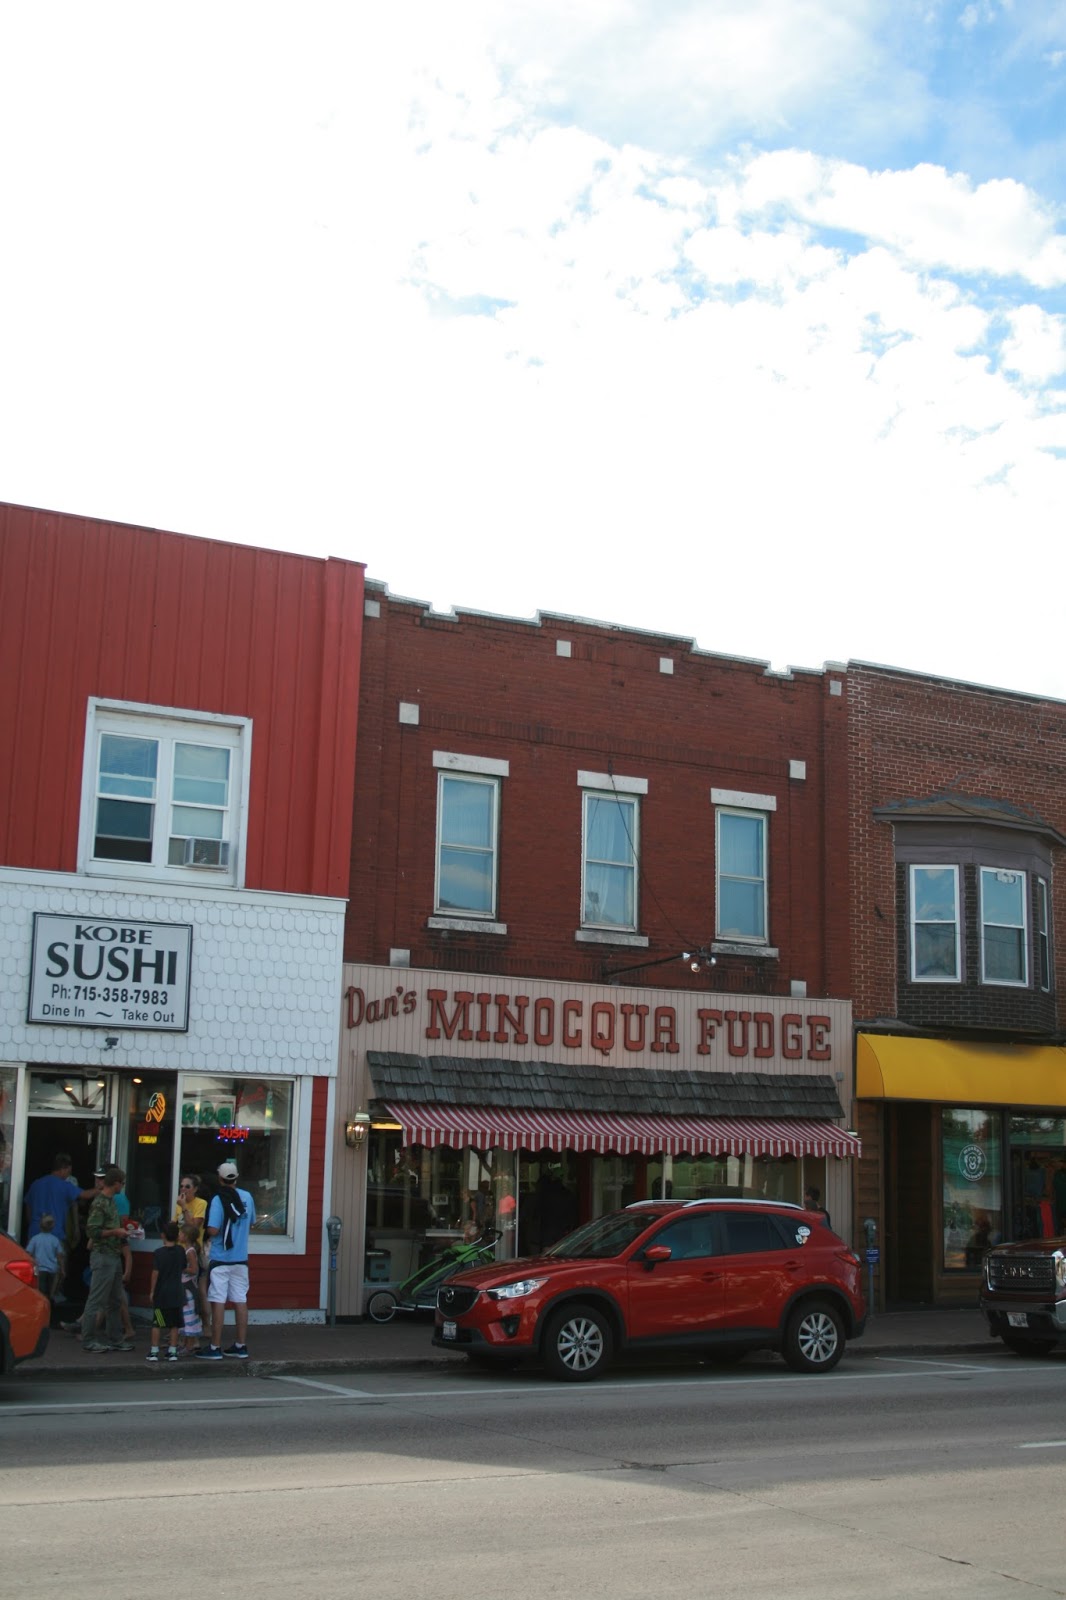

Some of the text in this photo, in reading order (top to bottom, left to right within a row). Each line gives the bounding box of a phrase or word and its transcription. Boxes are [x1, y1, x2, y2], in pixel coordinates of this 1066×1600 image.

[75, 925, 152, 945] KOBE
[46, 942, 178, 985] SUSHI
[42, 1004, 70, 1017] Dine
[74, 1006, 85, 1017] In
[122, 1009, 149, 1021] Take
[153, 1010, 175, 1022] Out
[344, 985, 832, 1060] Dan's MINOCQUA FUDGE
[219, 1127, 249, 1139] SUSHI
